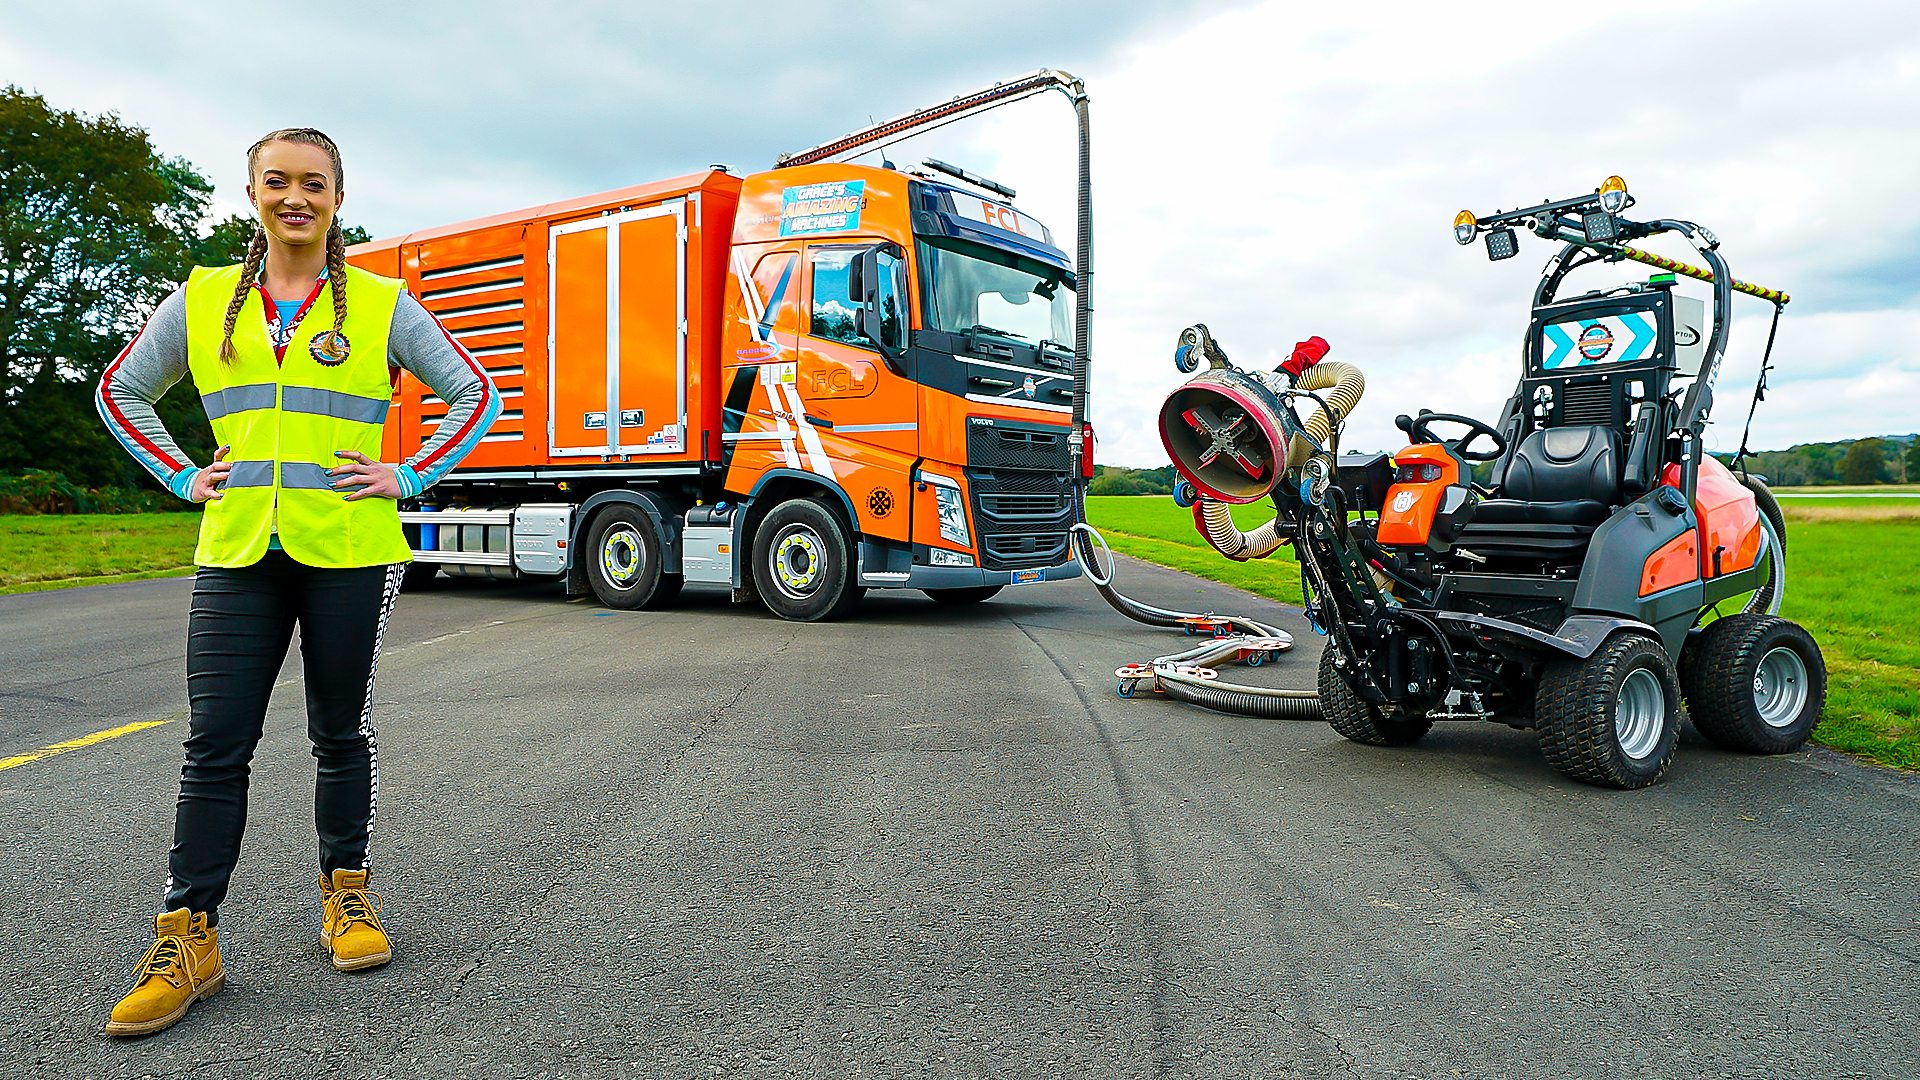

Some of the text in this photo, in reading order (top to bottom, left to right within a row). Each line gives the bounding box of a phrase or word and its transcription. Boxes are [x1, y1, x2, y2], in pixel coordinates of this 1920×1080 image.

[797, 184, 846, 200] GRACE'S
[783, 196, 859, 218] AMAZING
[791, 214, 847, 232] MACHINES
[981, 201, 1026, 236] FCL
[811, 368, 864, 392] FCL
[971, 417, 994, 426] VOLVO
